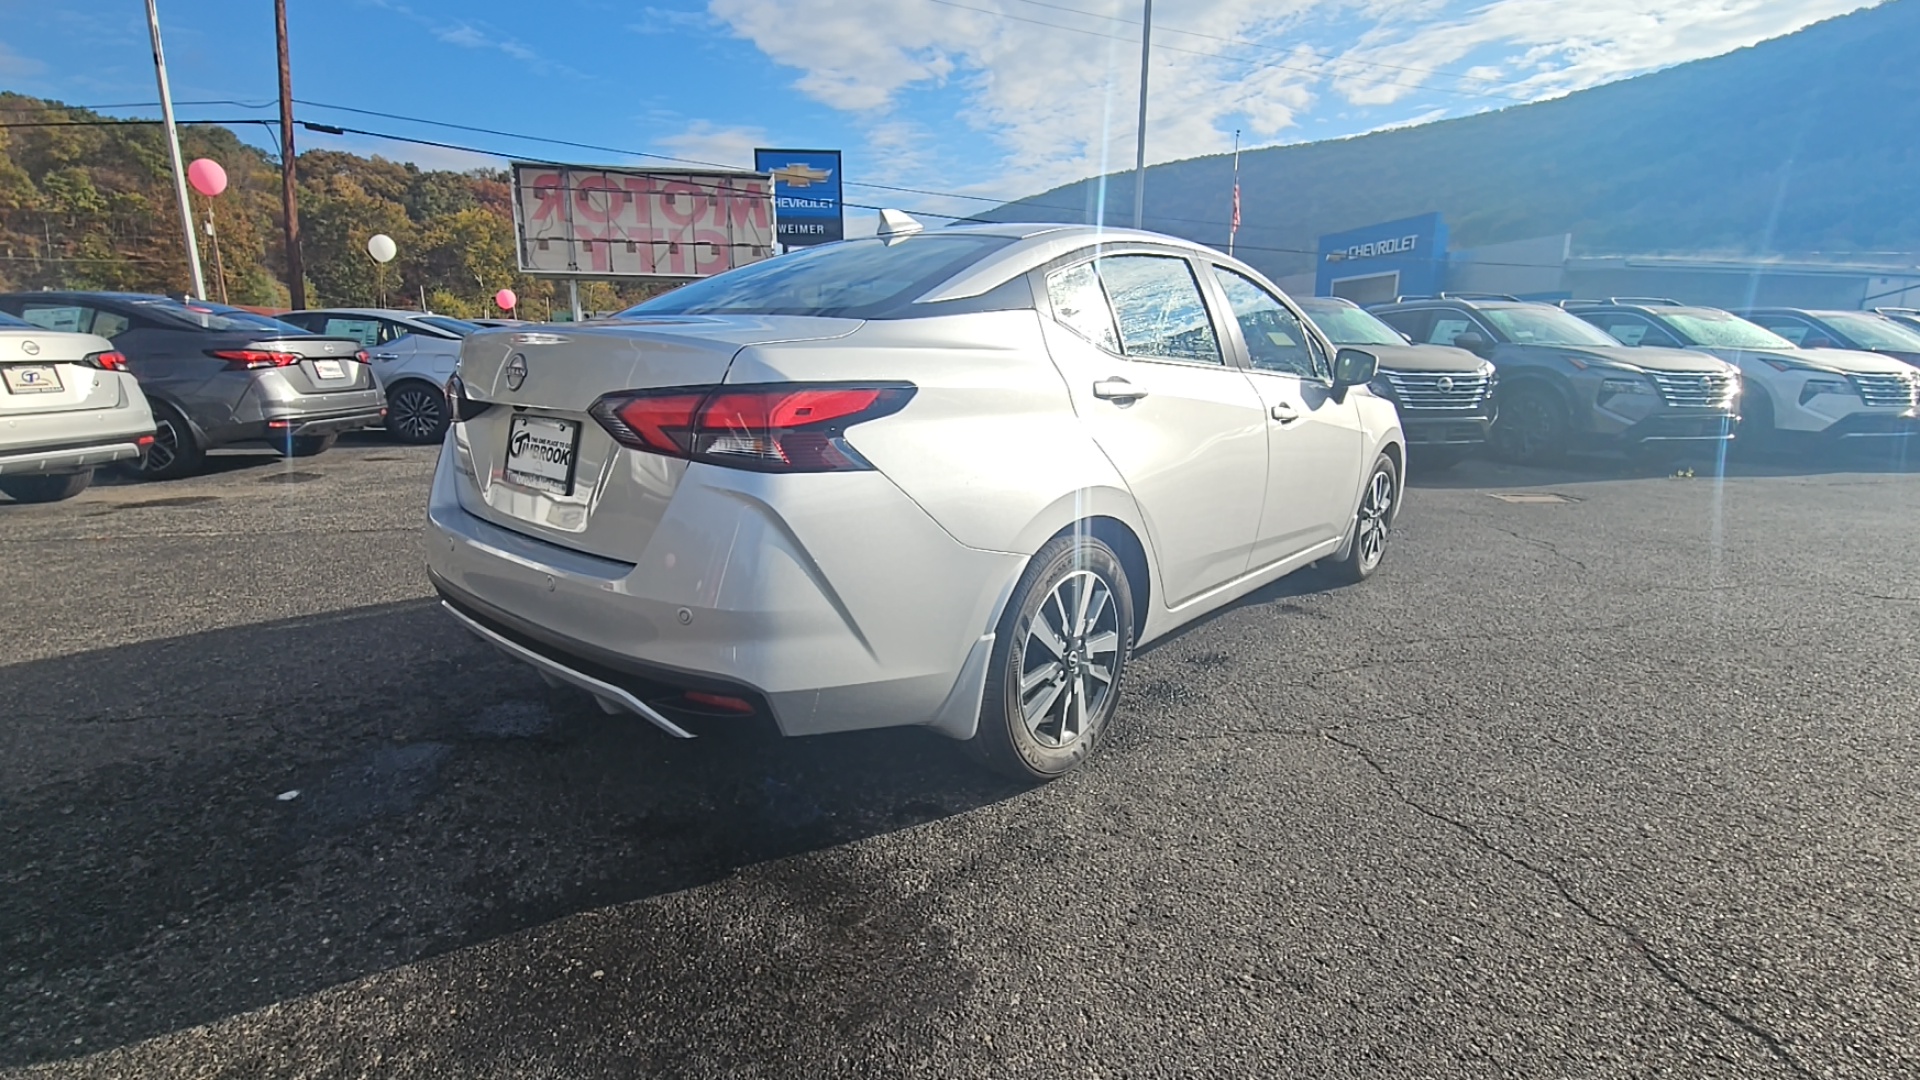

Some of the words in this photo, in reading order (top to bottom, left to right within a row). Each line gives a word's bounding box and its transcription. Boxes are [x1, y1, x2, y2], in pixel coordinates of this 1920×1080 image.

[775, 197, 835, 209] HEVROLET
[778, 224, 825, 235] WEIMER
[1348, 234, 1419, 260] CHEVROLET
